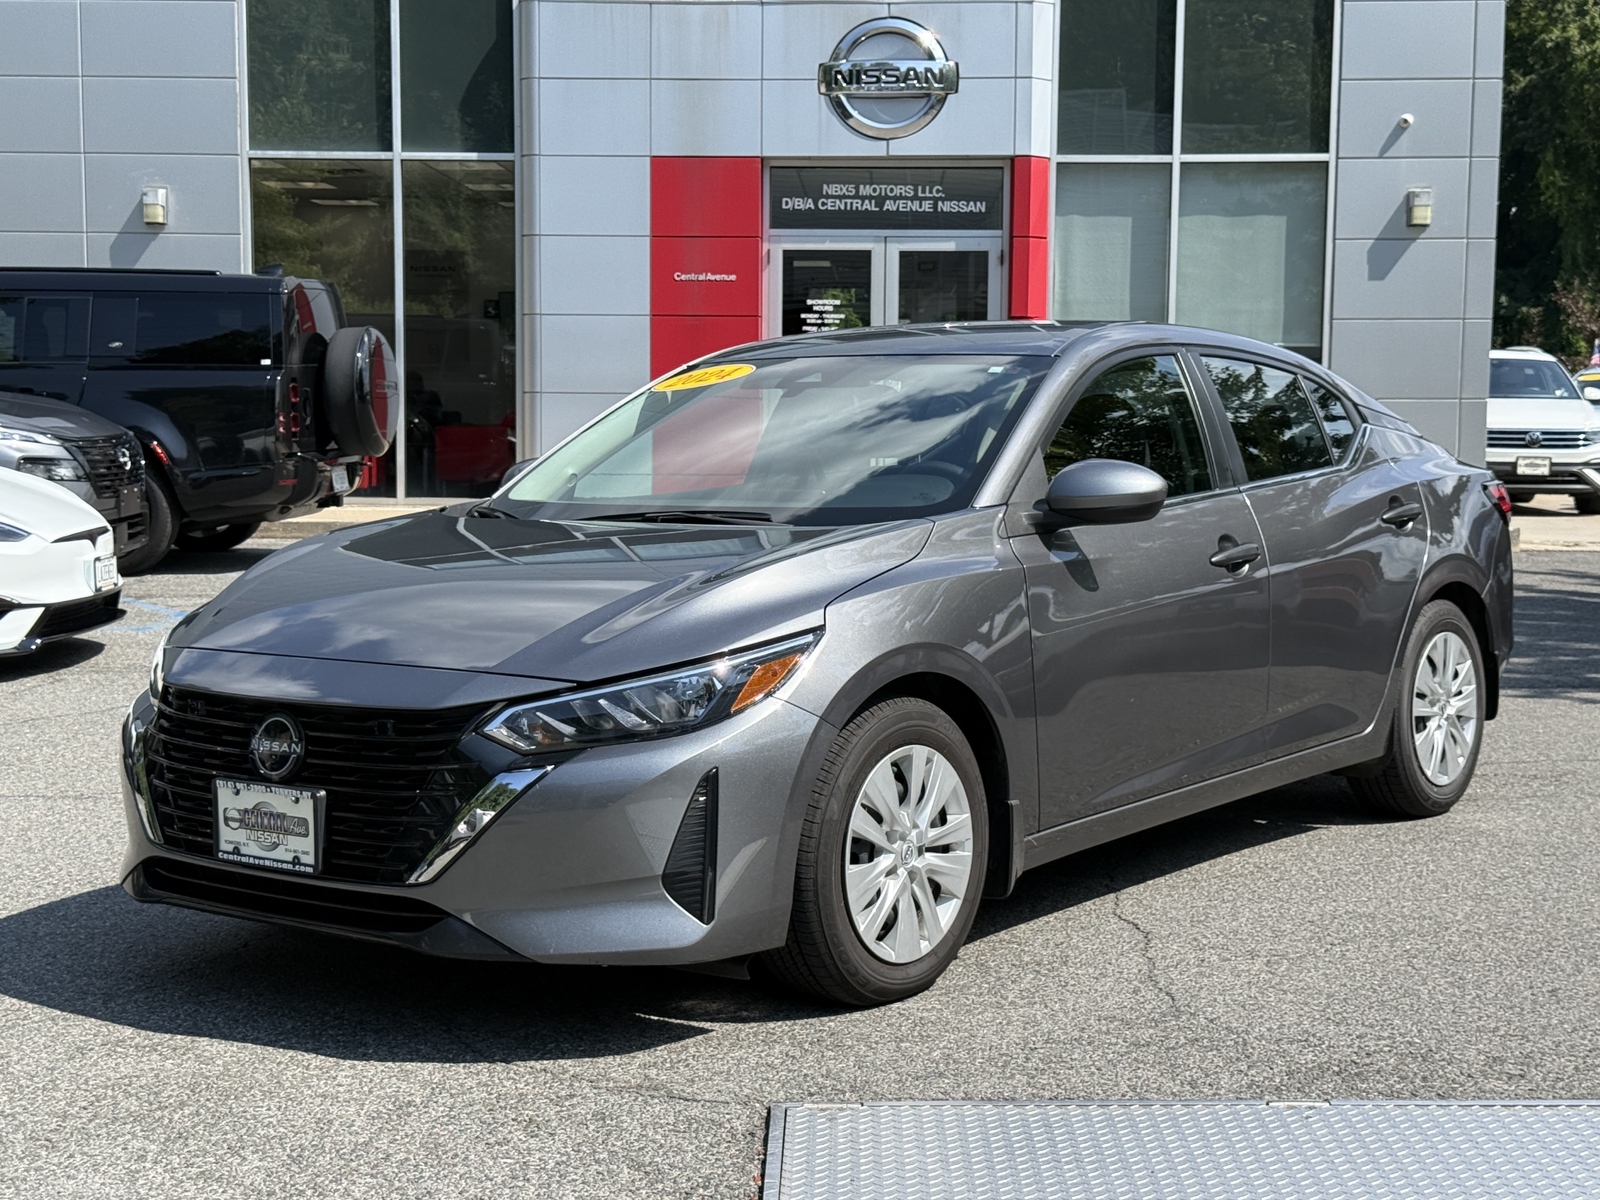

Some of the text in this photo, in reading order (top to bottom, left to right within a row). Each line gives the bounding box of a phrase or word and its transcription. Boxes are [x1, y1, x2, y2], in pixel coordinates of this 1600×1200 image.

[832, 66, 945, 87] NISSAN
[822, 184, 945, 197] NBX5 MOTORS LLC.
[781, 197, 986, 213] D/B/A CENTRAL AVENUE NISSAN
[409, 265, 457, 273] NISSAN
[673, 271, 737, 282] Central Avenue
[663, 366, 744, 389] 2024
[251, 736, 302, 753] NISSAN
[243, 808, 308, 836] CENTRAL Ave.
[246, 829, 289, 846] NISSAN
[218, 851, 314, 873] CentralAveNissan.com
